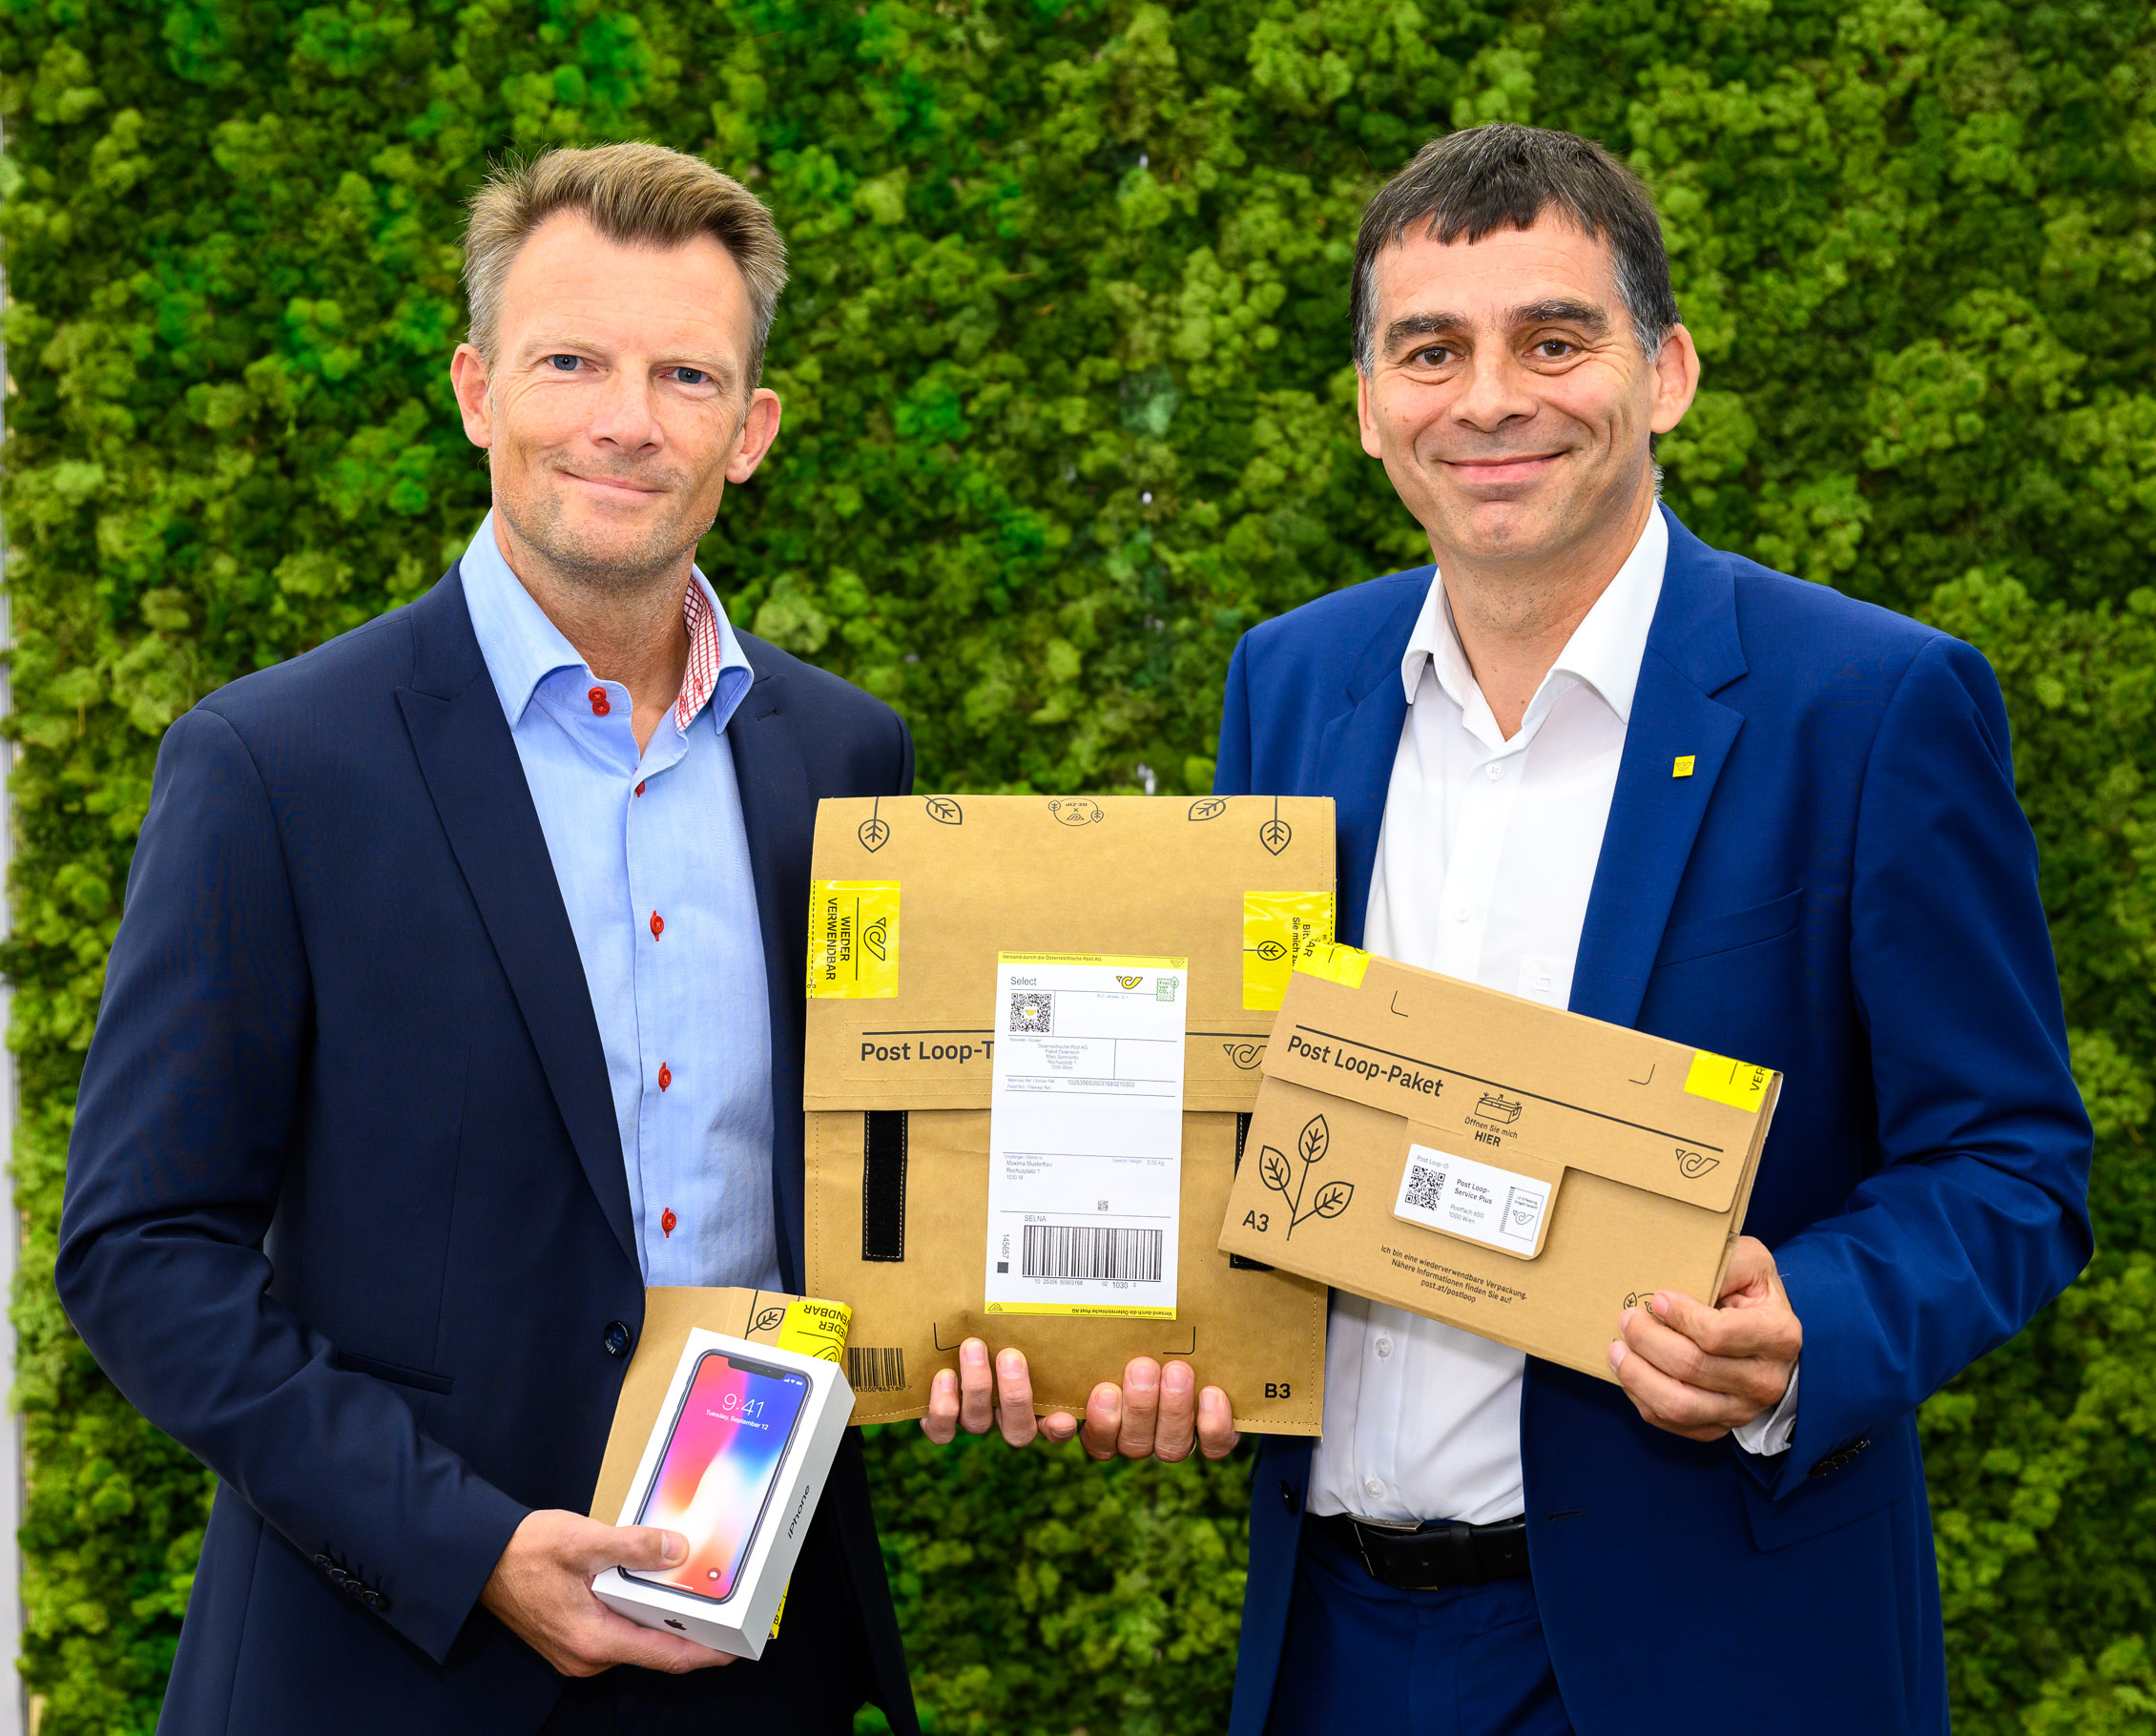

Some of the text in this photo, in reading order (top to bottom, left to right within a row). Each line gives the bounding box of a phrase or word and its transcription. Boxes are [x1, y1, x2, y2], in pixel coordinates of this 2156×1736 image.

[826, 898, 838, 981] VERWENDBAR
[840, 917, 851, 961] WIEDER
[1010, 976, 1037, 986] Select
[861, 1042, 911, 1062] Post
[1287, 1035, 1444, 1097] Post Loop-Paket
[1464, 1115, 1518, 1139] Öffnen Sie mich
[1474, 1130, 1502, 1147] HIER
[1417, 1154, 1449, 1169] Post Loop-ID
[1454, 1188, 1493, 1205] Service Plus
[1457, 1179, 1490, 1193] Post Loop-
[1242, 1209, 1270, 1232] A3
[1448, 1211, 1475, 1224] 1000 Wien
[1450, 1204, 1484, 1219] Postfach 650
[1002, 1234, 1010, 1259] 145657
[1380, 1245, 1527, 1300] Ich bin eine wiederverwendbare Verpackung.
[1391, 1258, 1512, 1304] Nähere Informationen finden Sie auf
[1420, 1279, 1477, 1303] post.at/postloop
[1264, 1382, 1291, 1399] B3
[722, 1393, 764, 1418] 9:41
[706, 1410, 729, 1421] Tuesday,
[730, 1416, 761, 1429] September
[787, 1484, 811, 1540] iPhone
